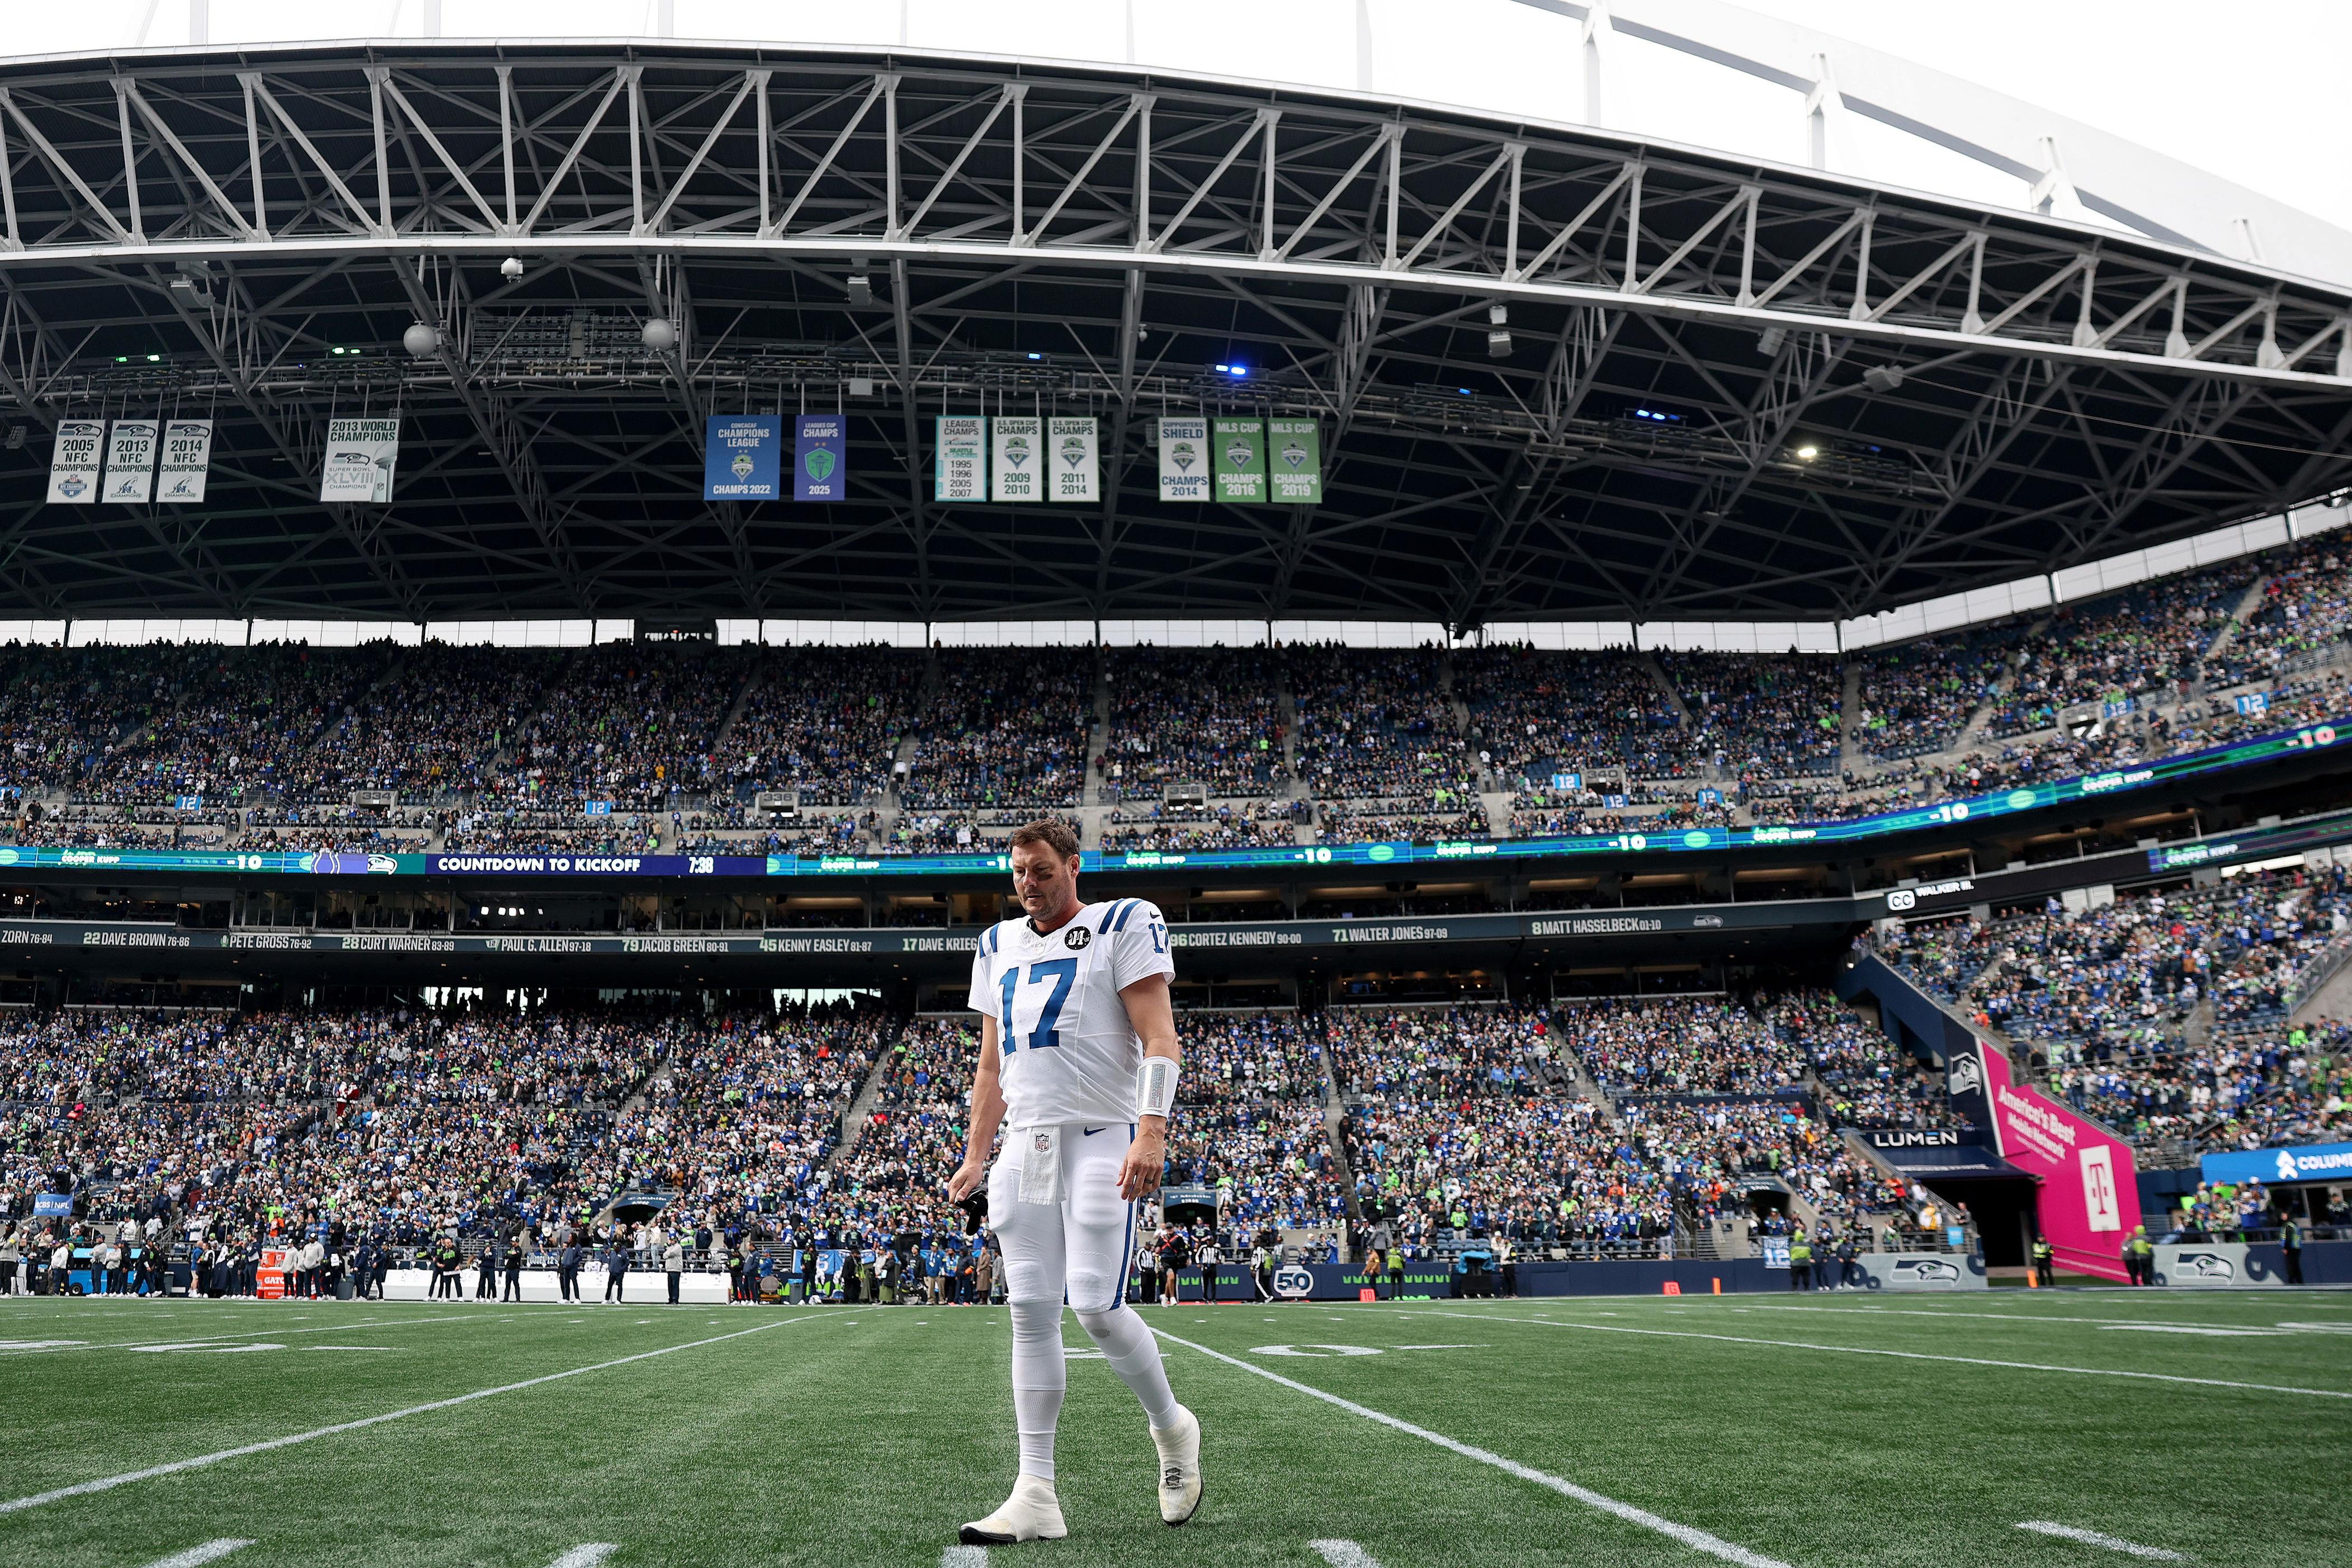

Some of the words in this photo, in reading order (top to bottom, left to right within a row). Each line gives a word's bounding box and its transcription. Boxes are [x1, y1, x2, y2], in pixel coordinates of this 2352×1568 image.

[332, 422, 358, 431] 2013
[361, 422, 396, 431] WORLD
[997, 426, 1037, 434] CHAMPS
[1052, 426, 1093, 434] CHAMPS
[1216, 423, 1238, 433] MLS
[1240, 423, 1260, 433] CUP
[1271, 423, 1293, 433] MLS
[1295, 423, 1315, 433] CUP
[330, 432, 395, 441] CHAMPIONS
[718, 429, 769, 438] CHAMPIONS
[803, 428, 838, 437] CHAMPS
[1163, 429, 1203, 438] SHIELD
[62, 440, 94, 451] 2005
[116, 440, 148, 452] 2013
[171, 440, 202, 452] 2014
[727, 438, 759, 447] LEAGUE
[65, 452, 88, 462] NFC
[120, 453, 142, 463] NFC
[174, 453, 196, 463] NFC
[53, 464, 98, 472] CHAMPIONS
[107, 464, 152, 473] CHAMPIONS
[162, 464, 206, 473] CHAMPIONS
[325, 473, 374, 484] XLVIII
[1004, 473, 1030, 483] 2009
[1061, 473, 1085, 483] 2011
[1162, 476, 1208, 485] CHAMPS
[1218, 473, 1263, 484] CHAMPS
[1274, 474, 1317, 484] CHAMPS
[713, 485, 748, 494] CHAMPS
[749, 485, 771, 494] 2022
[809, 485, 830, 494] 2025
[1004, 484, 1030, 494] 2010
[1061, 484, 1087, 494] 2014
[1172, 487, 1198, 495] 2014
[1226, 484, 1255, 495] 2016
[1282, 484, 1311, 496] 2019
[2241, 694, 2264, 712] 12
[2298, 725, 2336, 749] 10
[1588, 769, 1617, 778] 340
[1558, 775, 1575, 789] 12
[362, 792, 391, 800] 334
[1608, 795, 1623, 808] 12
[1702, 791, 1715, 804] 12
[182, 796, 196, 810] 12
[592, 802, 604, 814] 12
[1940, 802, 1969, 822] 10
[1618, 834, 1646, 851] 10
[1305, 847, 1331, 863] 10
[1437, 847, 1471, 856] COOPER
[1472, 846, 1498, 854] KUPP
[237, 854, 262, 870] 10
[438, 857, 544, 871] COUNTDOWN
[549, 858, 570, 871] TO
[575, 858, 641, 872] KICKOFF
[688, 857, 714, 873] 7:38
[1126, 856, 1160, 865] COOPER
[1161, 856, 1186, 864] KUPP
[1914, 882, 1961, 897] WALKER
[1532, 922, 1542, 935] 8
[1542, 920, 1571, 935] MATT
[1573, 918, 1640, 934] HASSELBECK
[1640, 919, 1661, 931] 01-10
[1, 930, 29, 944] ZORN
[30, 933, 53, 944] 76-84
[83, 932, 101, 944] 22
[102, 932, 127, 946] DAVE
[128, 933, 167, 946] BROWN
[167, 936, 190, 947] 76-86
[1149, 923, 1169, 953] 17
[1172, 933, 1188, 947] 96
[1189, 933, 1227, 946] CORTEZ
[1230, 931, 1276, 945] KENNEDY
[1277, 933, 1301, 944] 90-00
[1332, 929, 1349, 942] 71
[1349, 928, 1390, 942] WALTER
[1391, 926, 1424, 941] JONES
[1424, 928, 1447, 939] 97-09
[229, 936, 253, 948] PETE
[256, 936, 289, 949] GROSS
[290, 938, 312, 949] 76-92
[342, 937, 360, 950] 28
[360, 938, 386, 950] CURT
[388, 938, 430, 951] WARNER
[431, 941, 454, 951] 83-89
[502, 939, 526, 951] PAUL
[527, 940, 537, 951] G.
[539, 939, 569, 952] ALLEN
[569, 942, 591, 952] 97-18
[622, 939, 639, 952] 79
[639, 939, 671, 952] JACOB
[673, 939, 705, 952] GREEN
[706, 942, 729, 952] 80-91
[759, 939, 777, 952] 45
[778, 939, 811, 952] KENNY
[814, 939, 849, 952] EASLEY
[851, 942, 872, 952] 81-87
[903, 938, 918, 951] 17
[919, 938, 943, 951] DAVE
[946, 938, 978, 951] KRIEG
[999, 957, 1078, 1057] 17
[1998, 1084, 2049, 1130] America's
[2049, 1112, 2076, 1146] Best
[1875, 1131, 1958, 1146] LUMEN
[1037, 1141, 1047, 1150] NFL
[2090, 1163, 2108, 1215] T
[1764, 1238, 1789, 1249] VOLUME
[1765, 1249, 1790, 1266] 12
[1277, 1273, 1310, 1291] 50
[1669, 1284, 1677, 1293] G
[1363, 1291, 1374, 1300] 10
